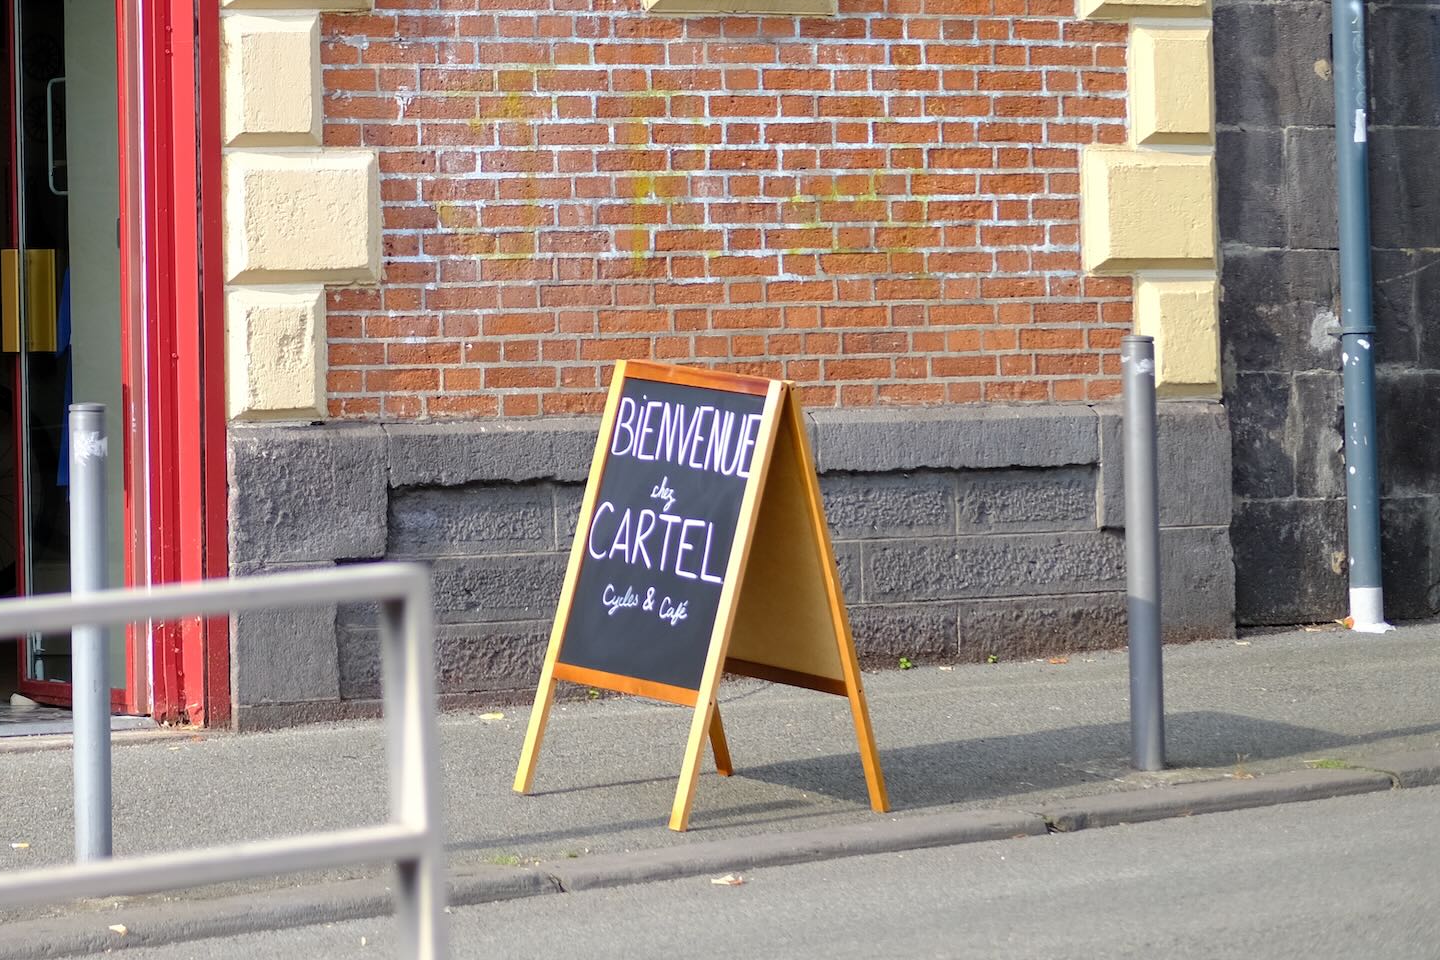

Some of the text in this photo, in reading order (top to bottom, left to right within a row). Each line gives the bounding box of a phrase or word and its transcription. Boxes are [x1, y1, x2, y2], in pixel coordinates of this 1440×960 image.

[650, 476, 677, 512] chez
[589, 501, 724, 584] CARTEL
[602, 584, 689, 625] Cycles & Café
